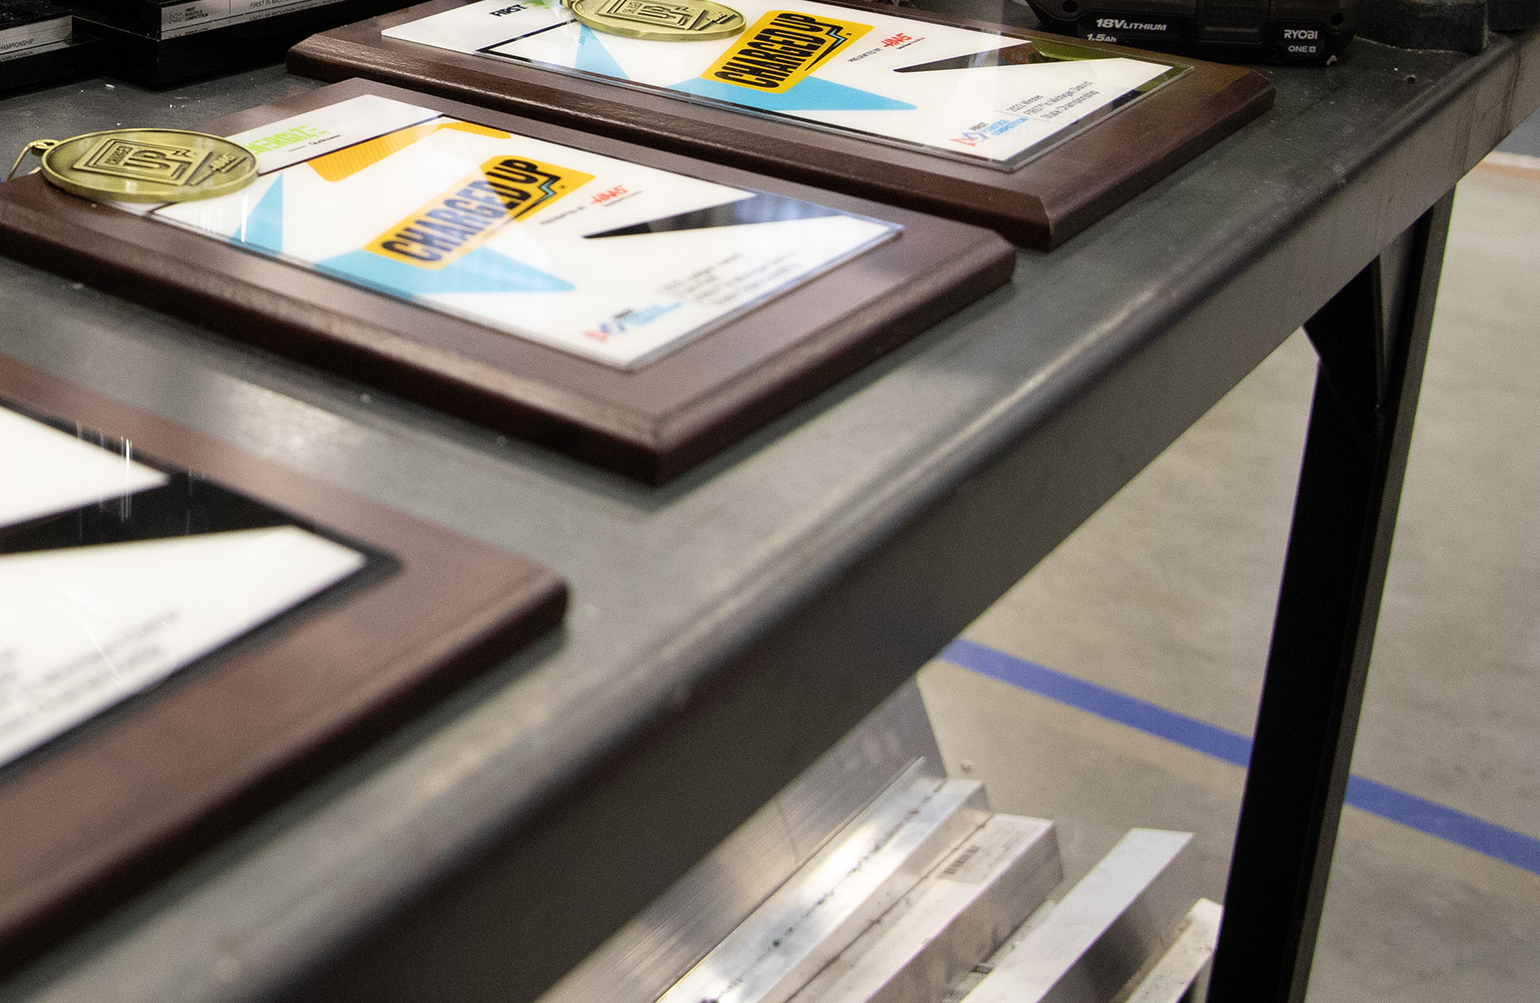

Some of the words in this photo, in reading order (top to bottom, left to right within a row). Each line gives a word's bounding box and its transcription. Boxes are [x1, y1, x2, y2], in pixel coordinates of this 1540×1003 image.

[249, 0, 266, 9] FIRST
[488, 4, 528, 17] FIRST
[770, 13, 832, 33] UP
[1096, 18, 1124, 29] 18V
[1123, 22, 1167, 31] LITHIUM
[1086, 33, 1117, 43] 1.5Ah
[1284, 29, 1319, 40] RYOBI
[714, 28, 827, 88] CHARGED
[248, 125, 330, 155] NERGIZE
[381, 180, 533, 262] CHARGED
[485, 158, 560, 185] UP
